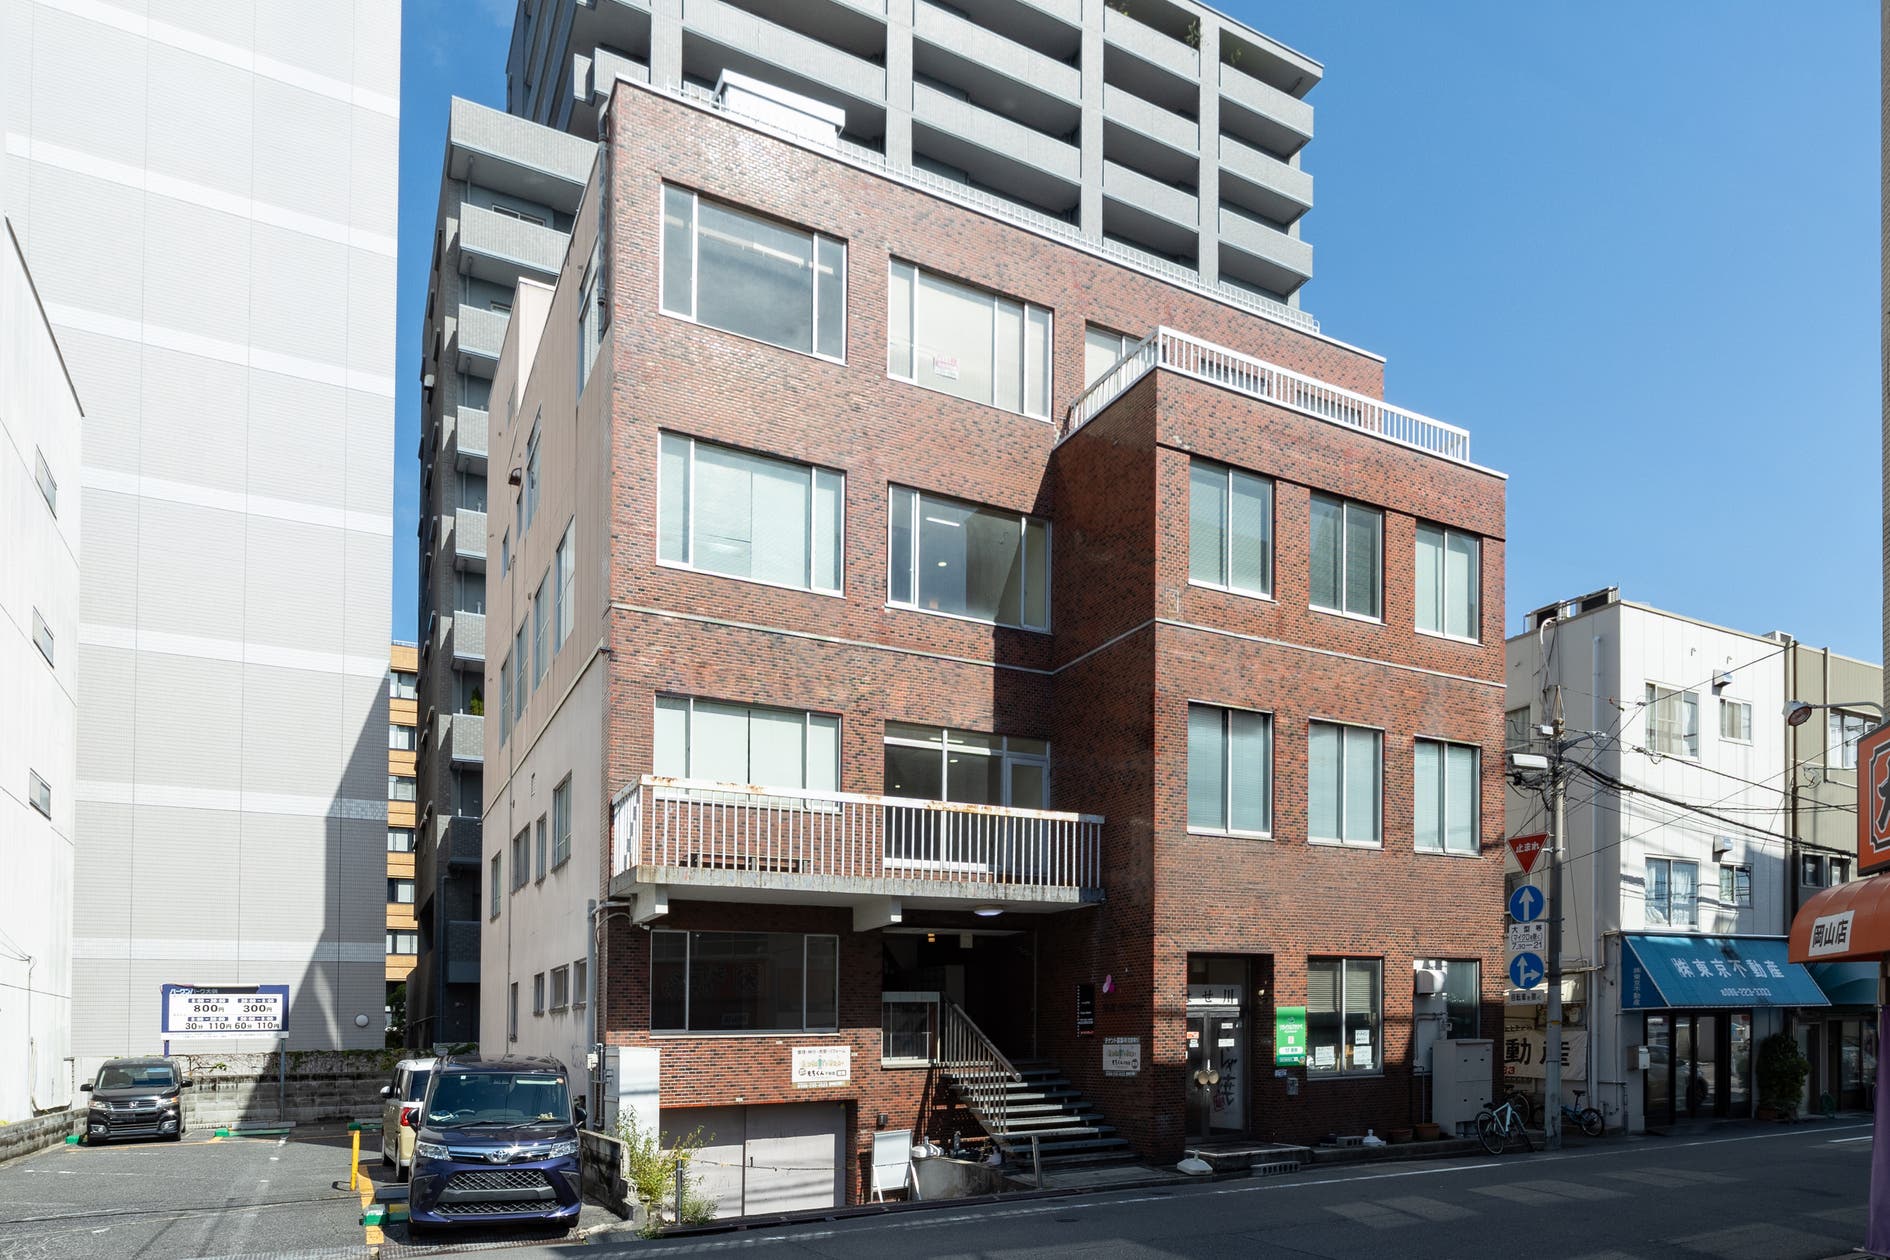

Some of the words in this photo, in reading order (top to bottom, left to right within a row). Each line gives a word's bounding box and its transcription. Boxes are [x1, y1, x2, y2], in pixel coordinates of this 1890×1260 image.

[1516, 841, 1540, 853] 止まれ
[1511, 924, 1542, 933] 大型等
[1812, 918, 1849, 948] 岡山店
[193, 1004, 225, 1013] 800円
[243, 1004, 273, 1013] 300円
